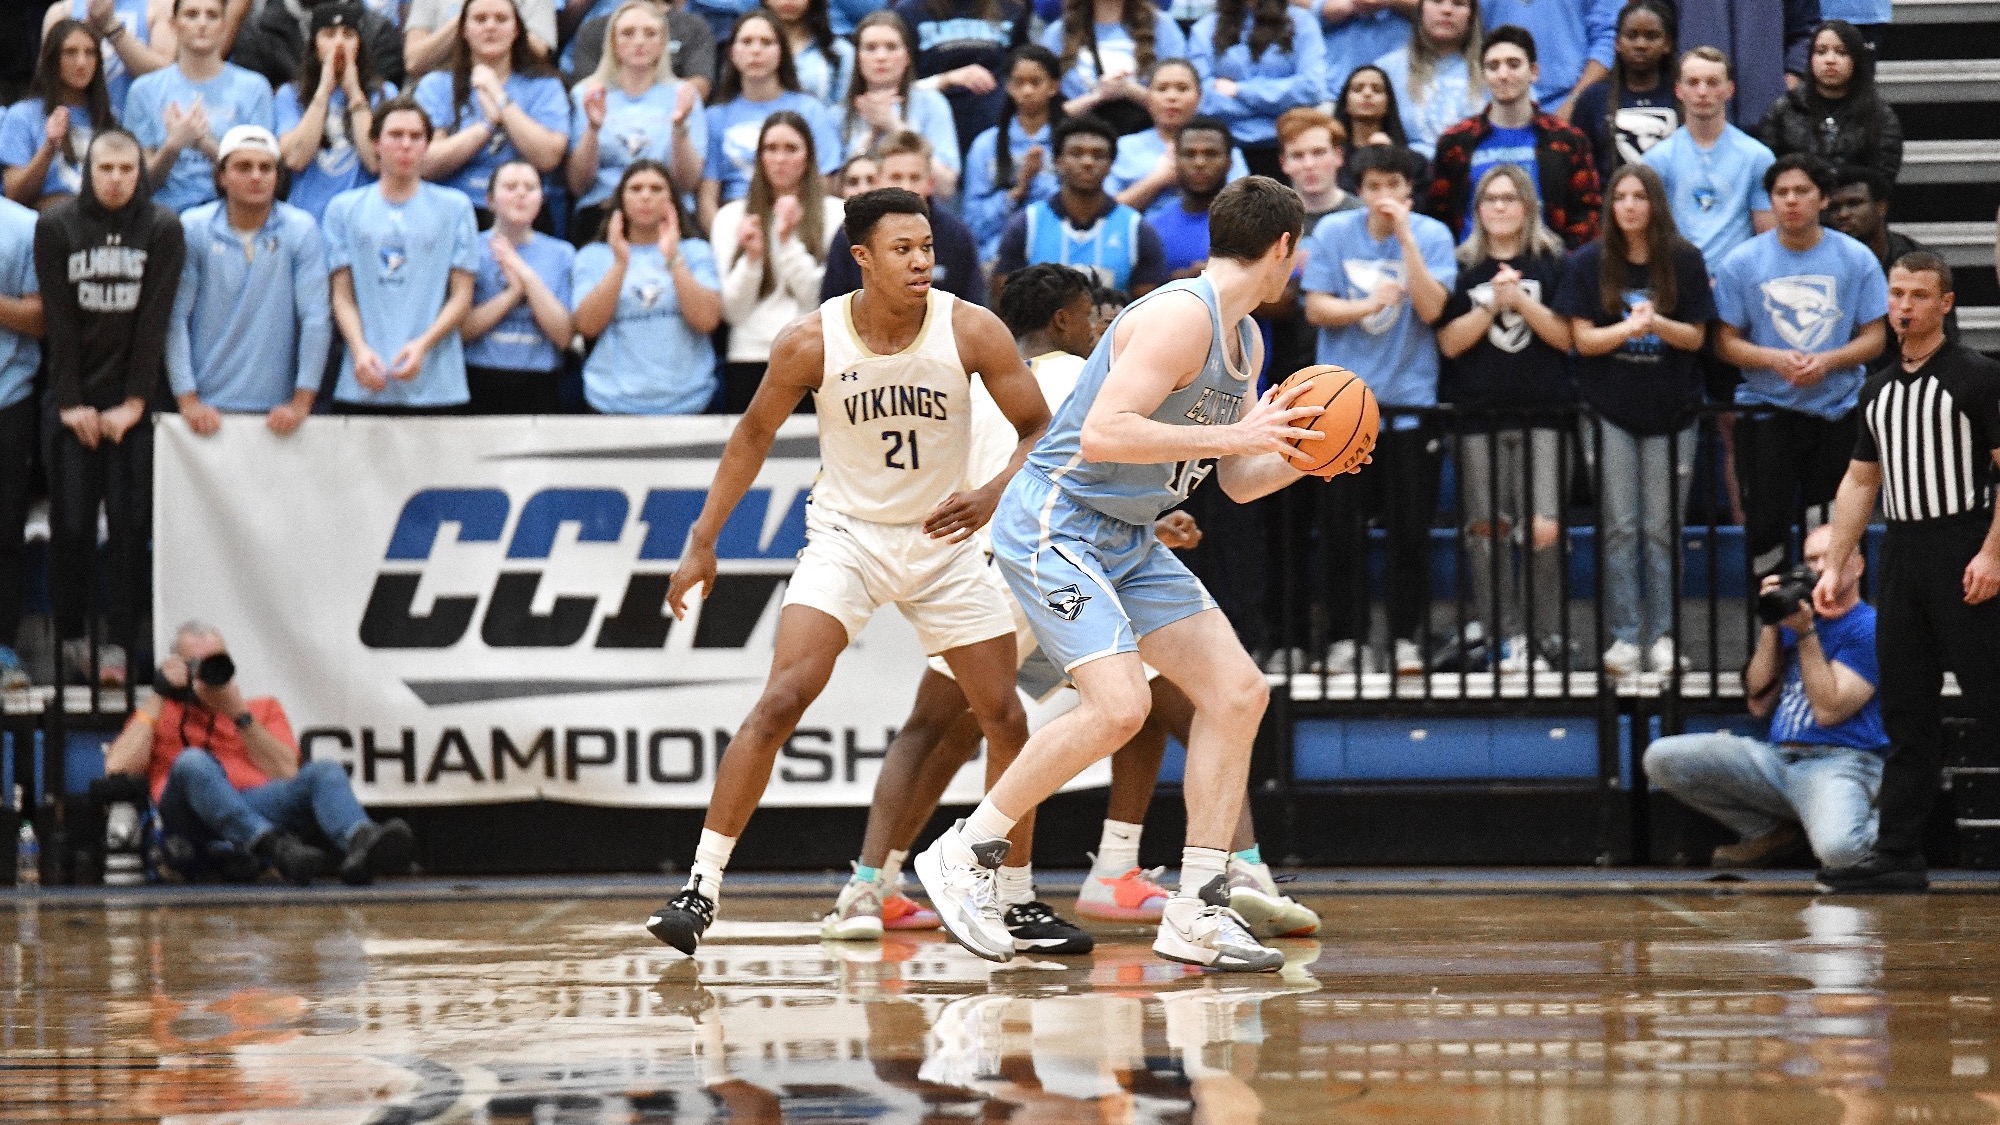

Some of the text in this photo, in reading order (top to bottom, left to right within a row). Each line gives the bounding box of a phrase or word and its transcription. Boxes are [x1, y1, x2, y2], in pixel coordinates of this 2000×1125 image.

[844, 385, 948, 426] VIKINGS
[881, 429, 919, 470] 21
[1343, 432, 1371, 469] EVO
